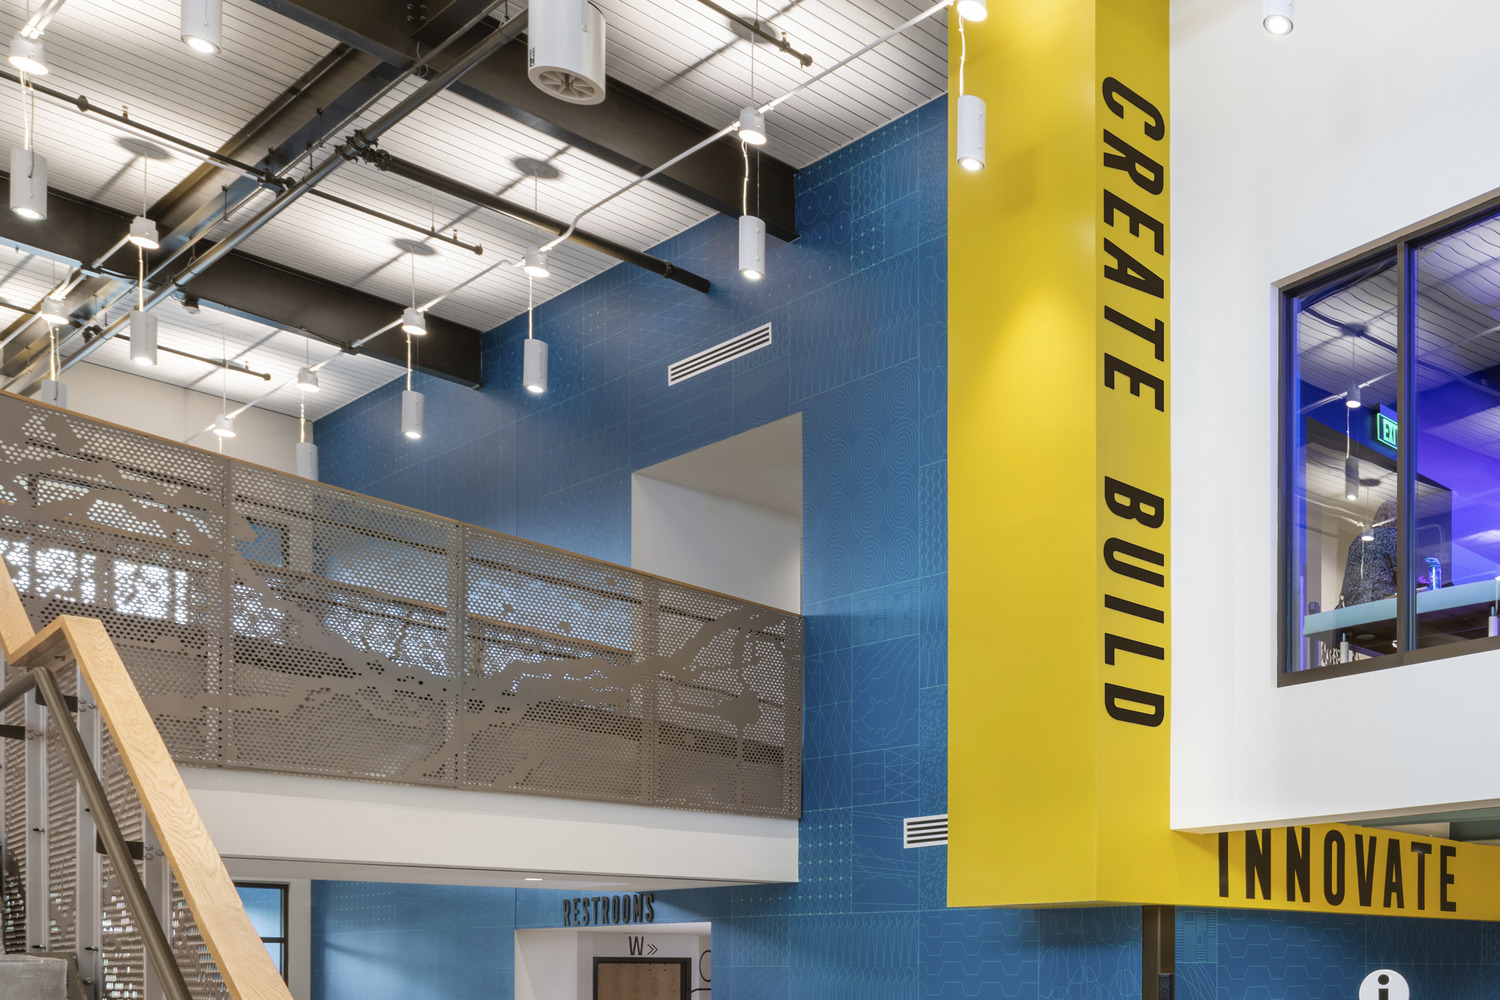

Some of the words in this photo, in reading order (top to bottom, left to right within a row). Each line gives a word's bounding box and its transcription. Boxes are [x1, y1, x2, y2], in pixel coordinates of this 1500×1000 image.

[1101, 76, 1165, 413] CREATE
[1103, 475, 1165, 728] BUILD
[562, 892, 655, 927] RESTROOMS
[1218, 826, 1457, 913] INNOVATE
[628, 936, 645, 956] W
